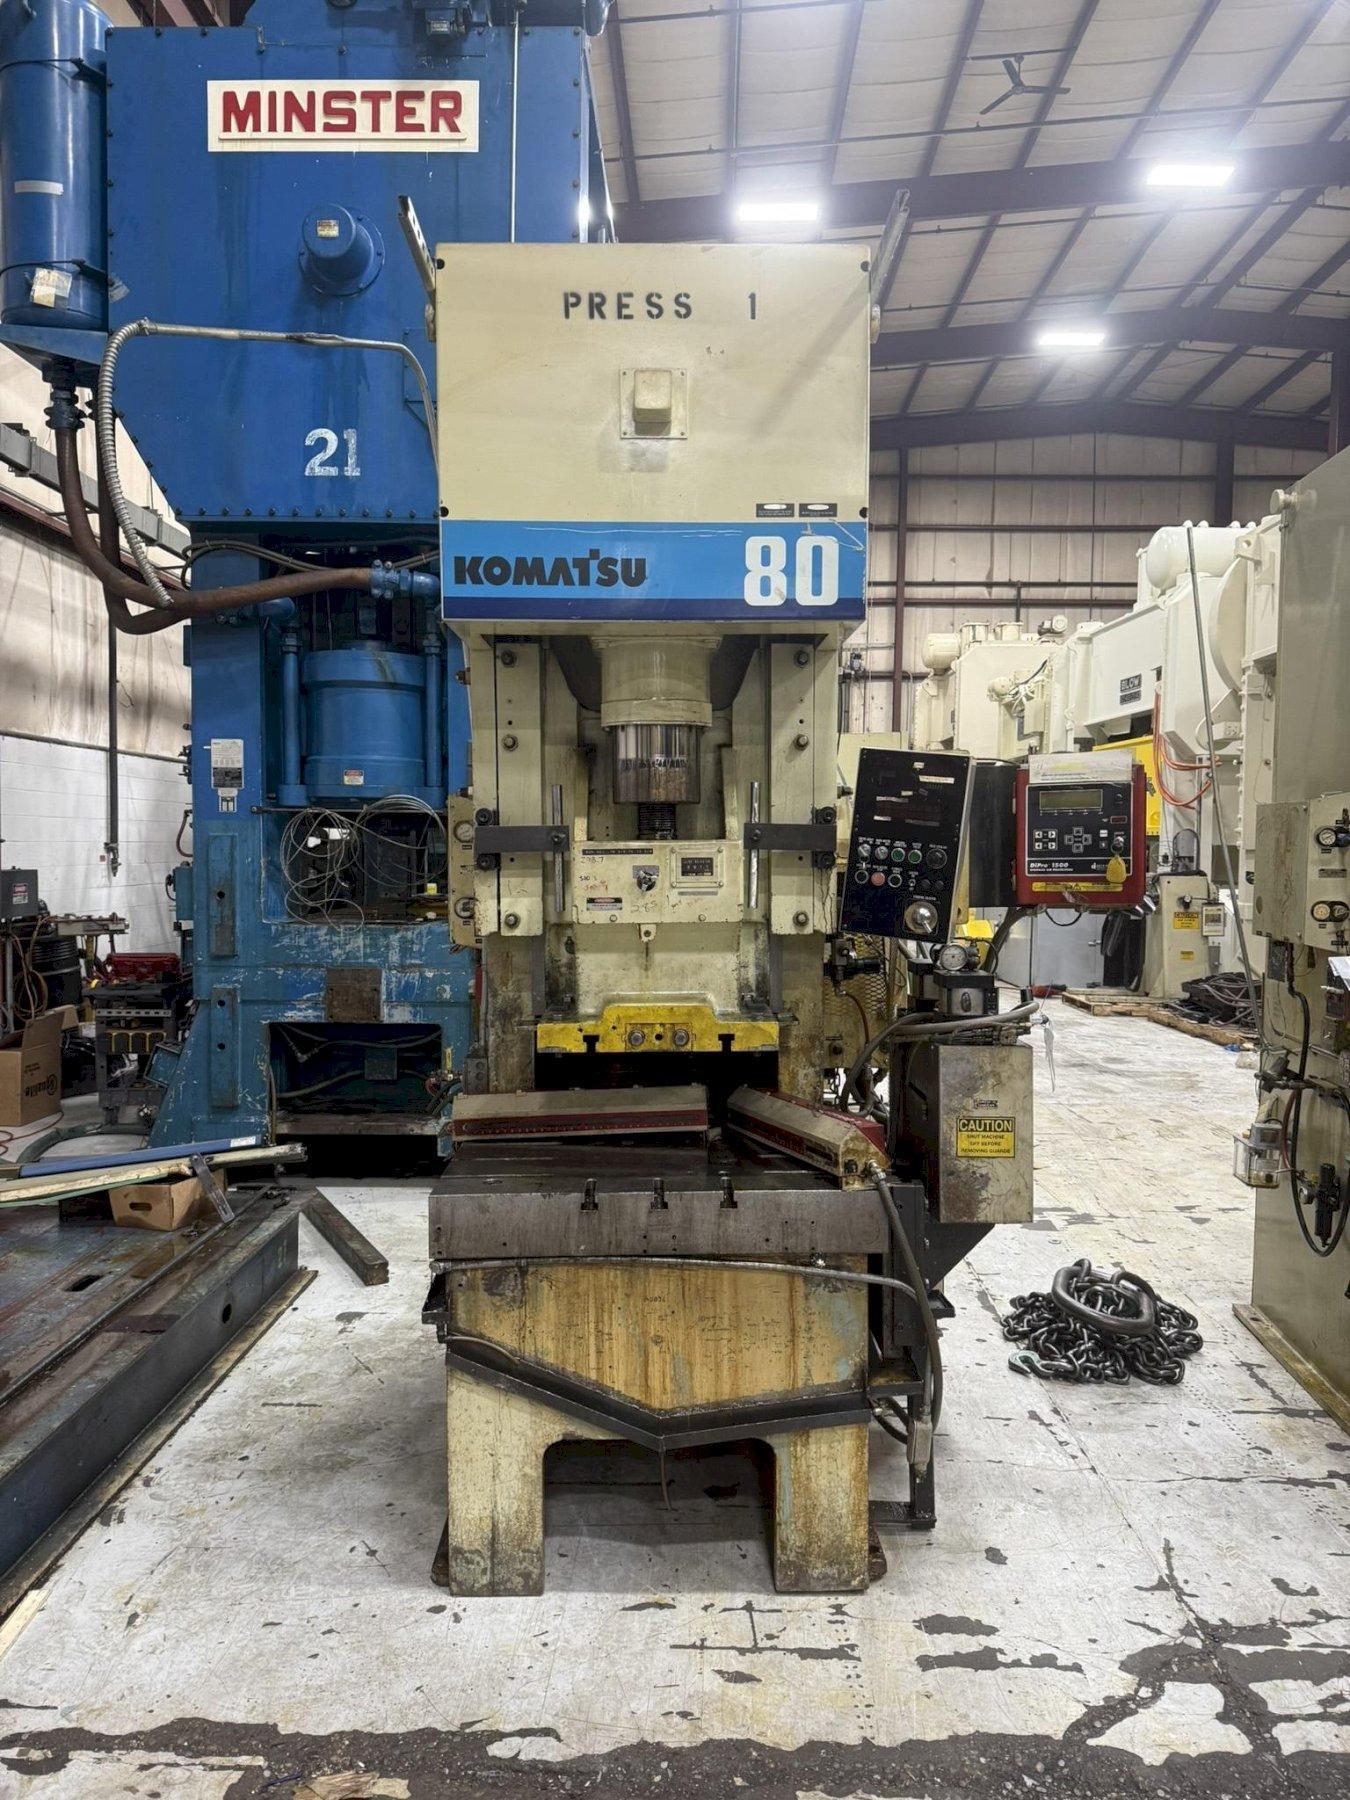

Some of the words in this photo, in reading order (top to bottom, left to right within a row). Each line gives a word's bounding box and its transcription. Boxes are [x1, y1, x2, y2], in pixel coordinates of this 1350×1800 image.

[221, 90, 464, 133] MINSTER
[563, 291, 693, 320] PRESS
[747, 292, 757, 320] 1
[303, 428, 362, 477] 21
[453, 548, 648, 588] KOMATSU
[743, 534, 840, 607] 80
[959, 1119, 1012, 1132] CAUTION
